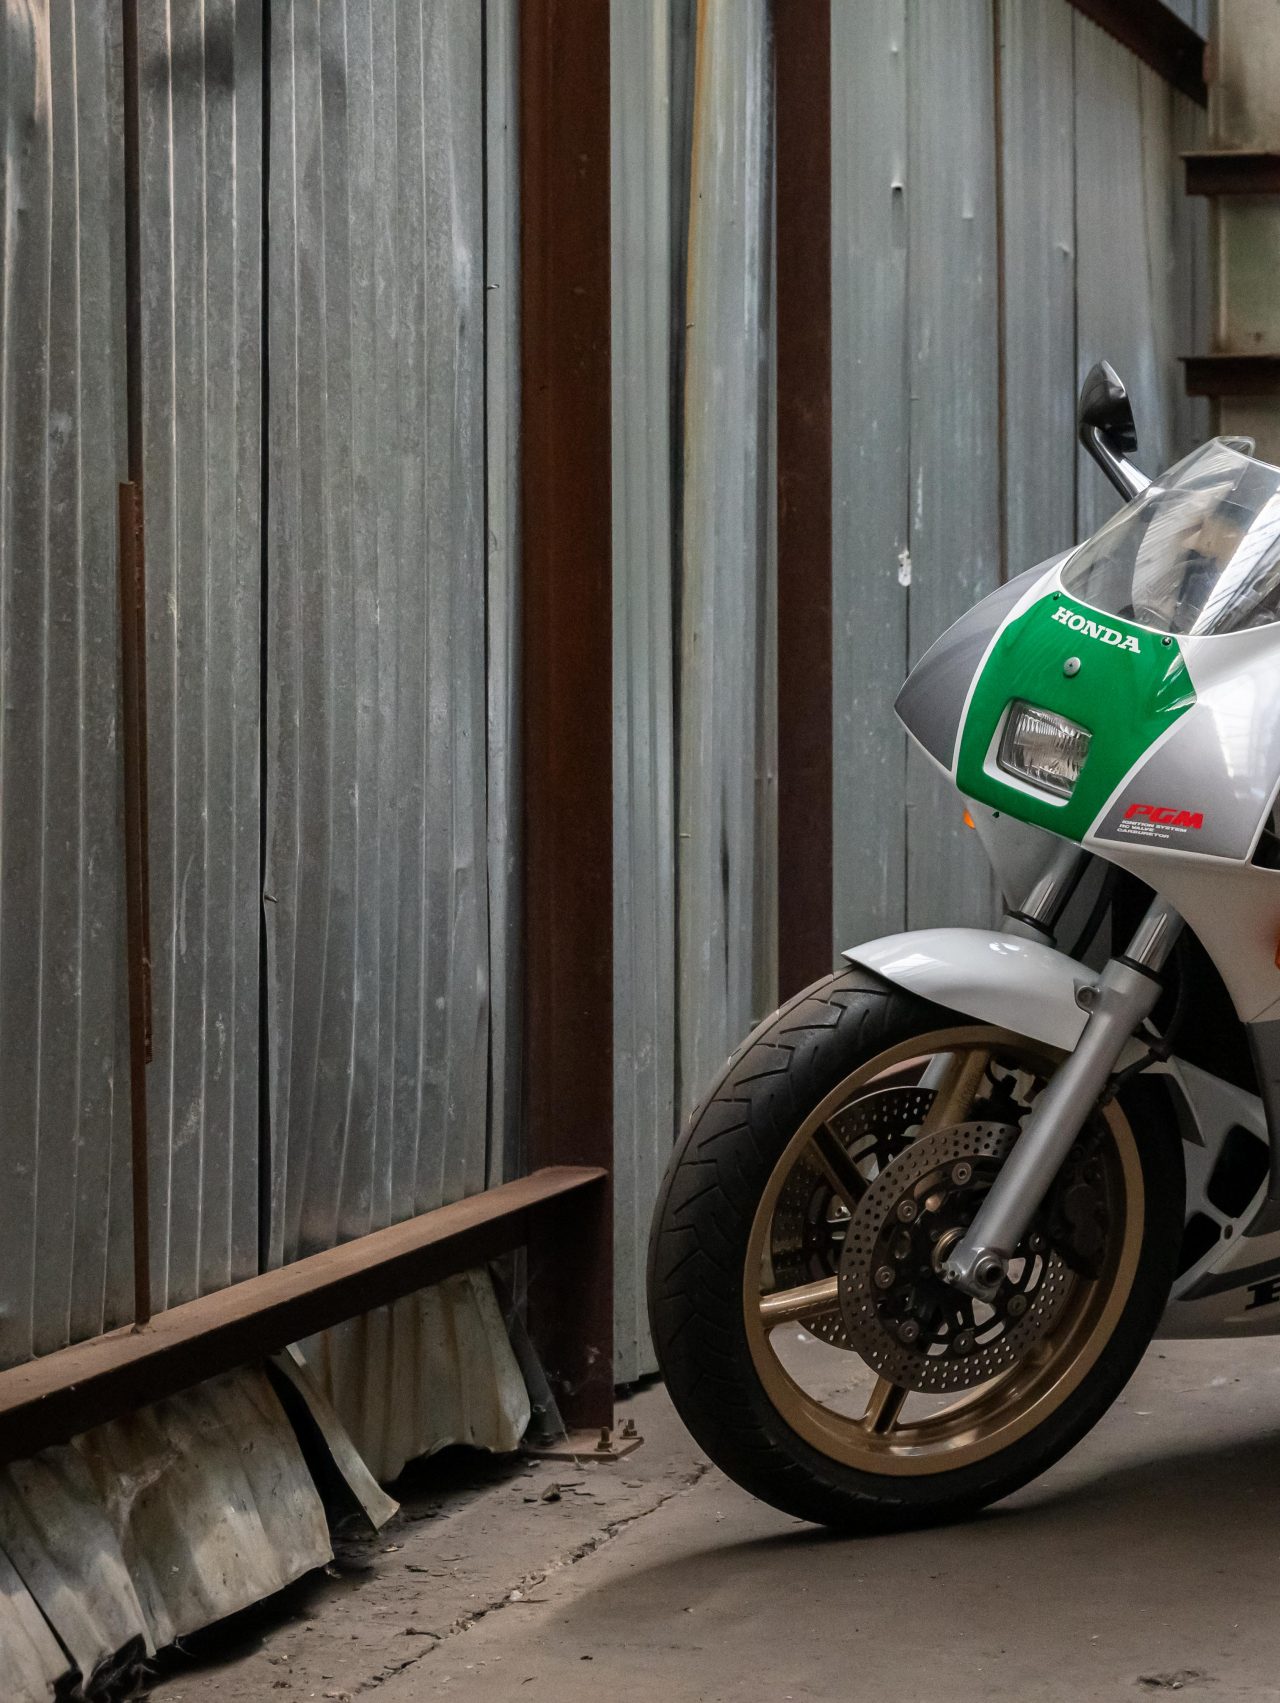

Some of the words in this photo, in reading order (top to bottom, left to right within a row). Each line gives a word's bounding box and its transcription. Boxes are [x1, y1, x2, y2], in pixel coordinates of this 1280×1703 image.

[1051, 606, 1141, 654] HONDA
[1121, 820, 1154, 828] IGNITION
[1155, 824, 1188, 833] SYSTEM
[1123, 803, 1204, 830] PGM
[1117, 828, 1170, 838] CARBURETOR
